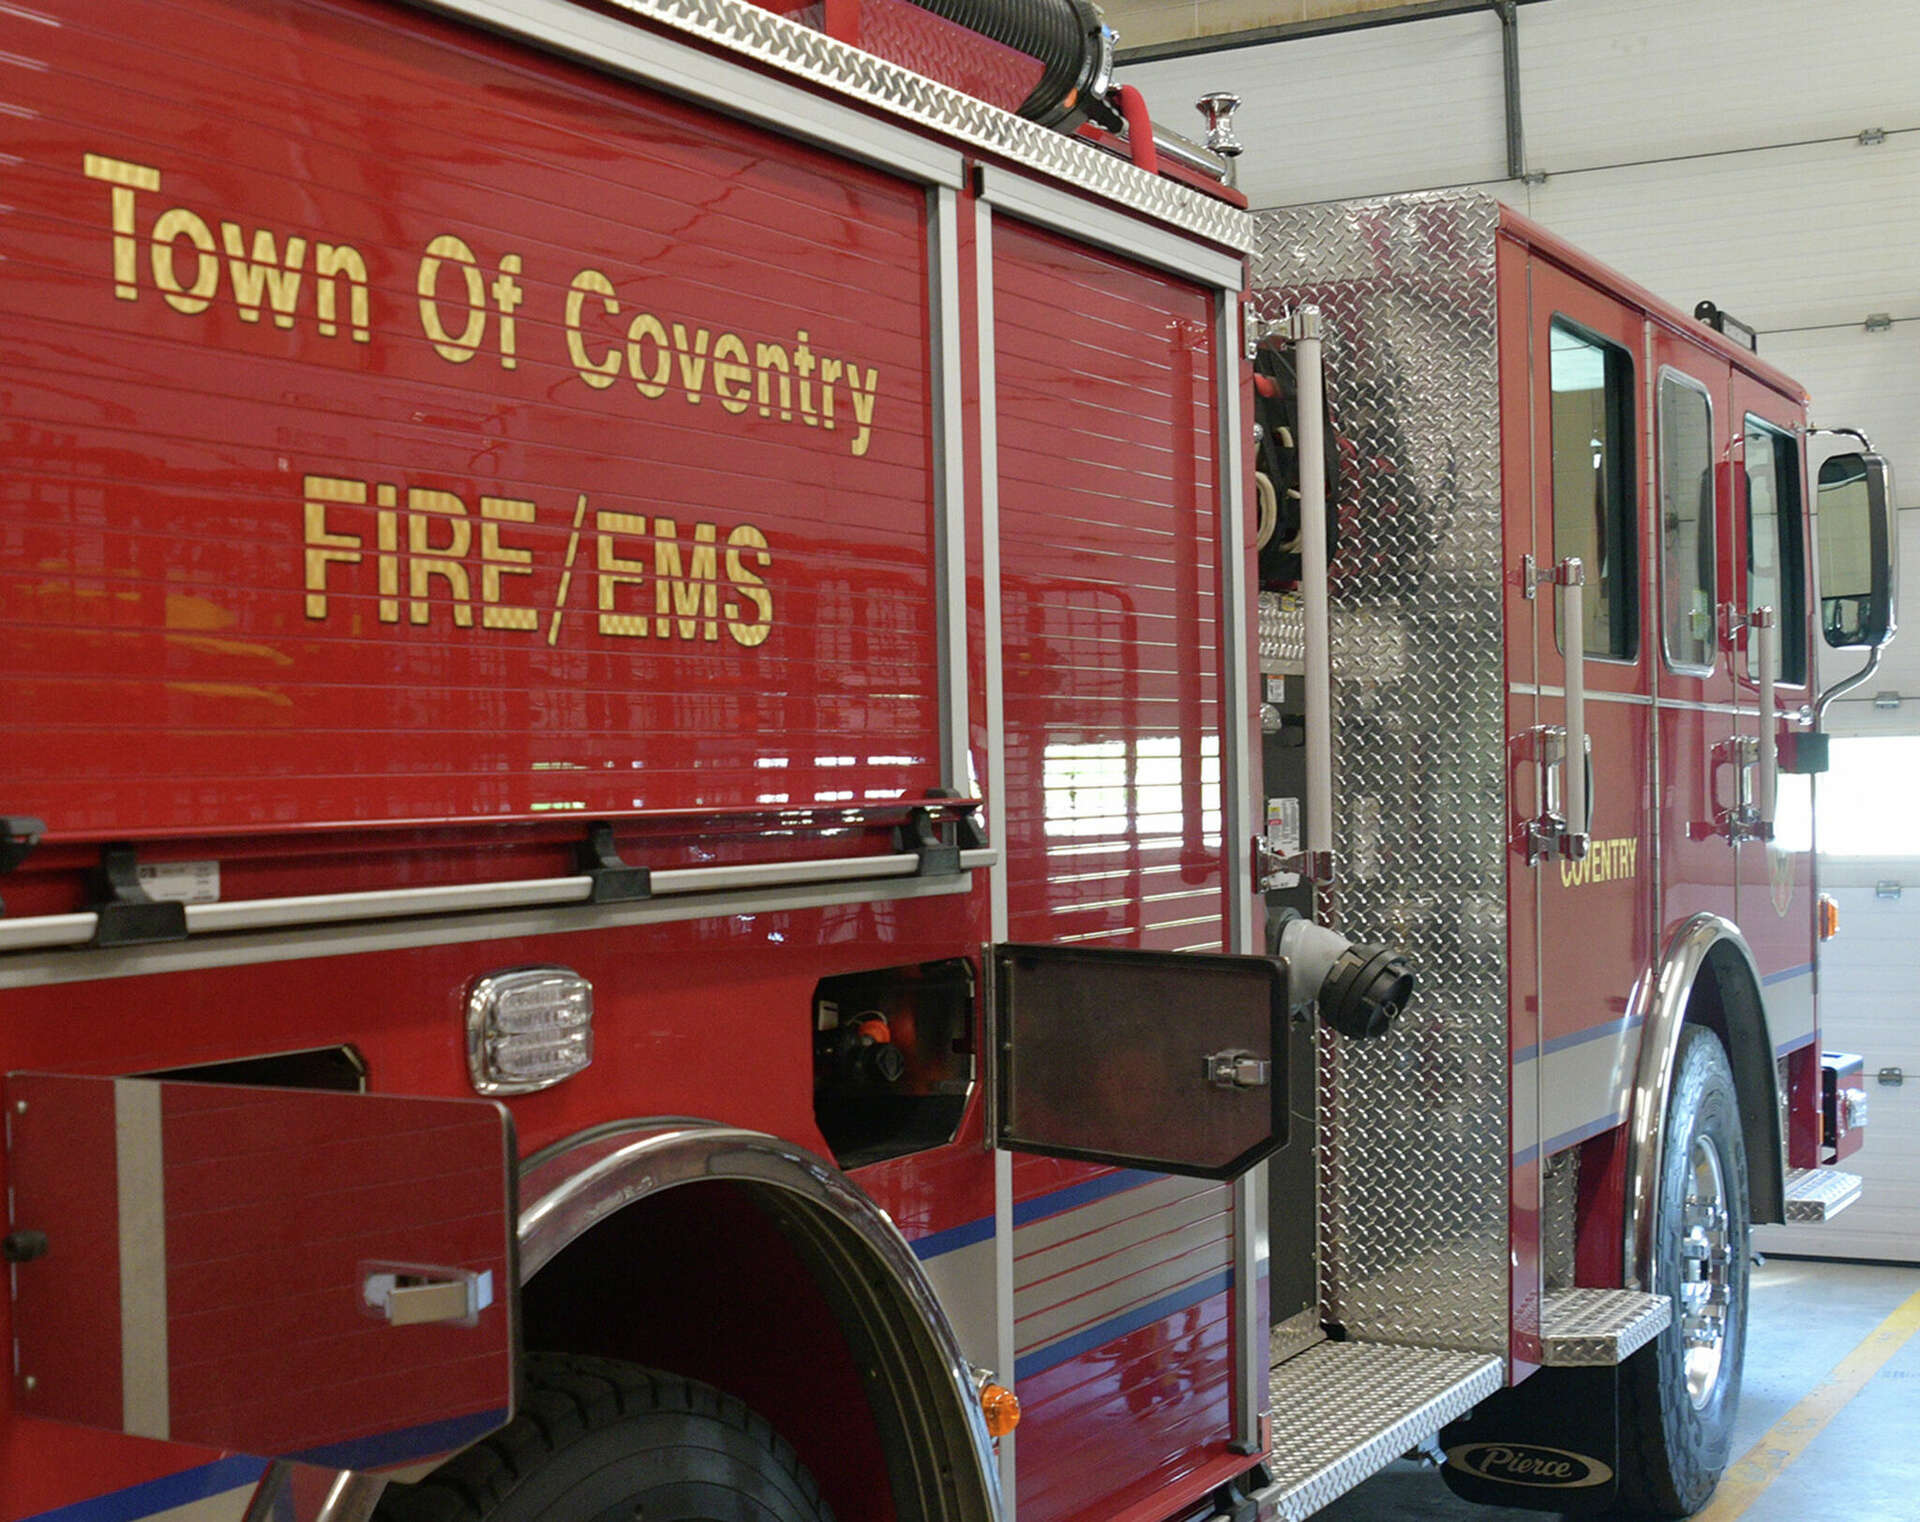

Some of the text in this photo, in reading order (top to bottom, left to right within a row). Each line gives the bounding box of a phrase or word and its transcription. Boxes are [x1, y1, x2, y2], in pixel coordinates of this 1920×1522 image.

[83, 153, 879, 457] Town Of Coventry
[304, 475, 774, 647] FIRE/EMS
[1479, 1447, 1572, 1478] Pierce
